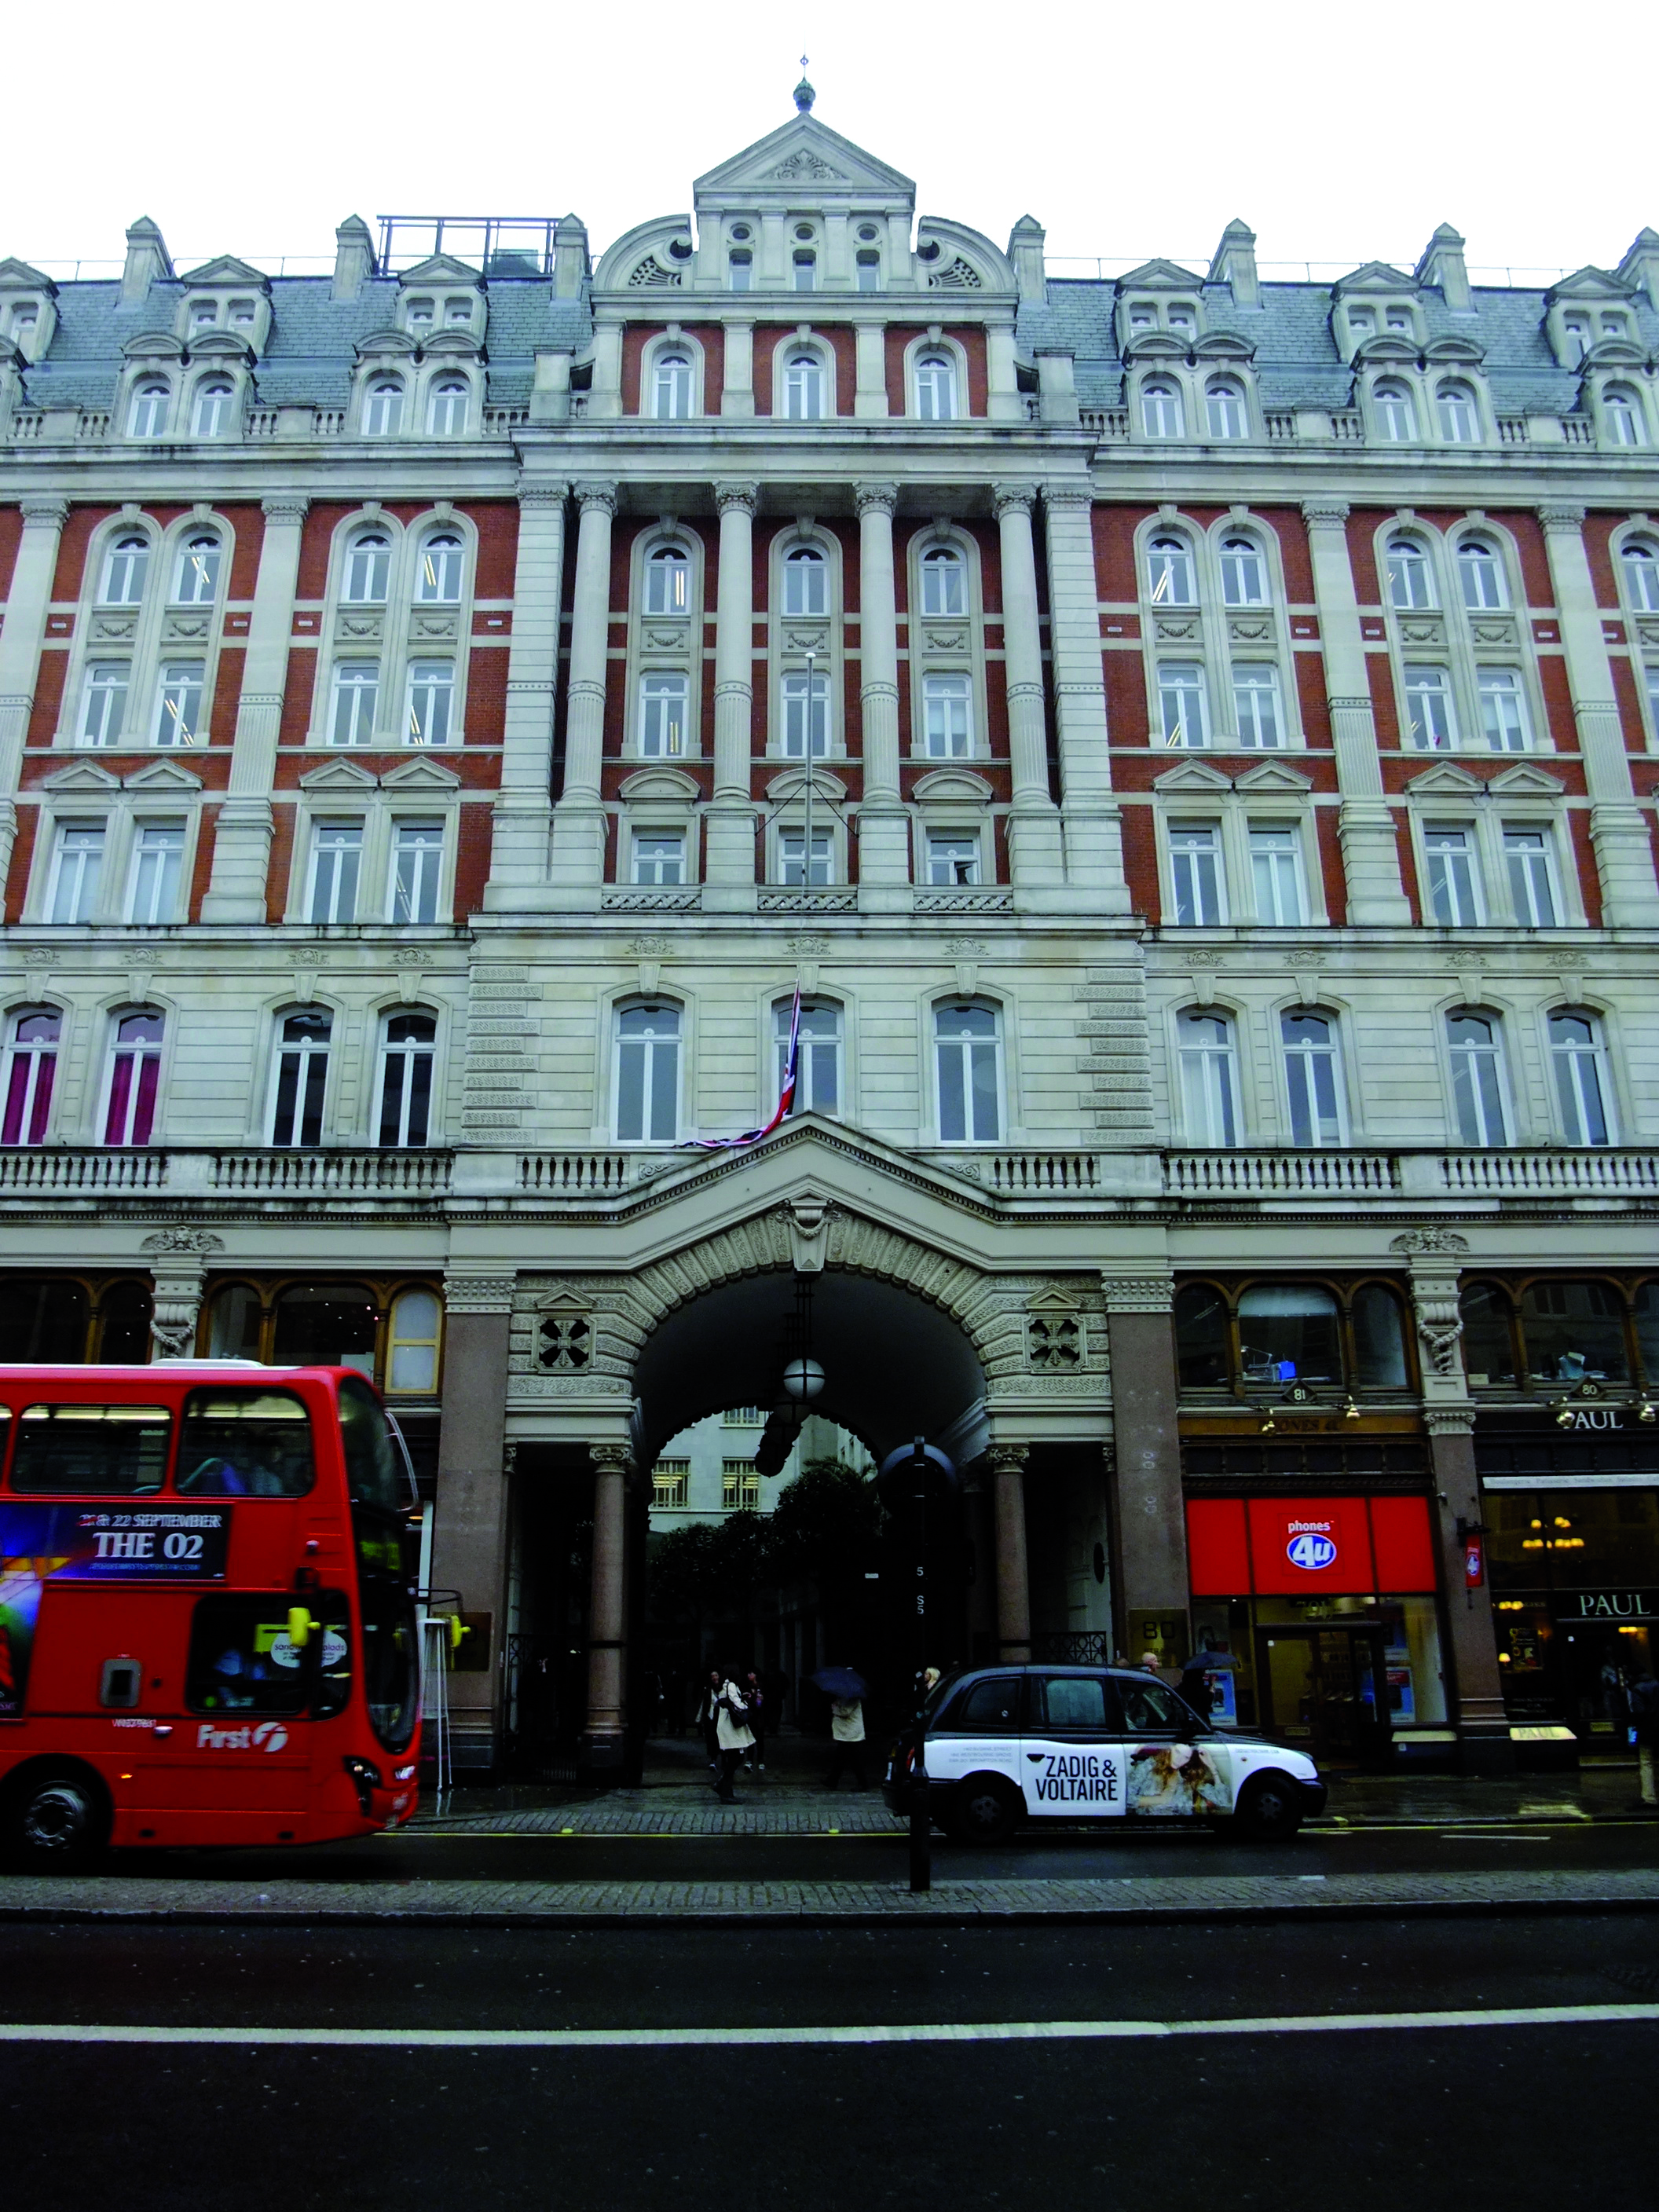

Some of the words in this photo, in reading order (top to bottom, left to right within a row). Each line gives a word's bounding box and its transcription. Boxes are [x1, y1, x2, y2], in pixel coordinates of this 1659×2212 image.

[1294, 1388, 1306, 1401] 81
[1582, 1384, 1597, 1395] 80
[1558, 1411, 1624, 1429] AUL
[112, 1514, 132, 1527] 22
[132, 1514, 222, 1528] SEPTEMBER
[1287, 1519, 1331, 1534] phones
[93, 1532, 156, 1558] THE
[916, 1566, 924, 1577] 5
[1579, 1595, 1650, 1616] PAUL
[1143, 1621, 1175, 1639] 80
[196, 1724, 251, 1749] First
[1046, 1756, 1098, 1778] ZADIG
[1102, 1759, 1117, 1778] &
[1035, 1778, 1118, 1800] VOLTAIRE
